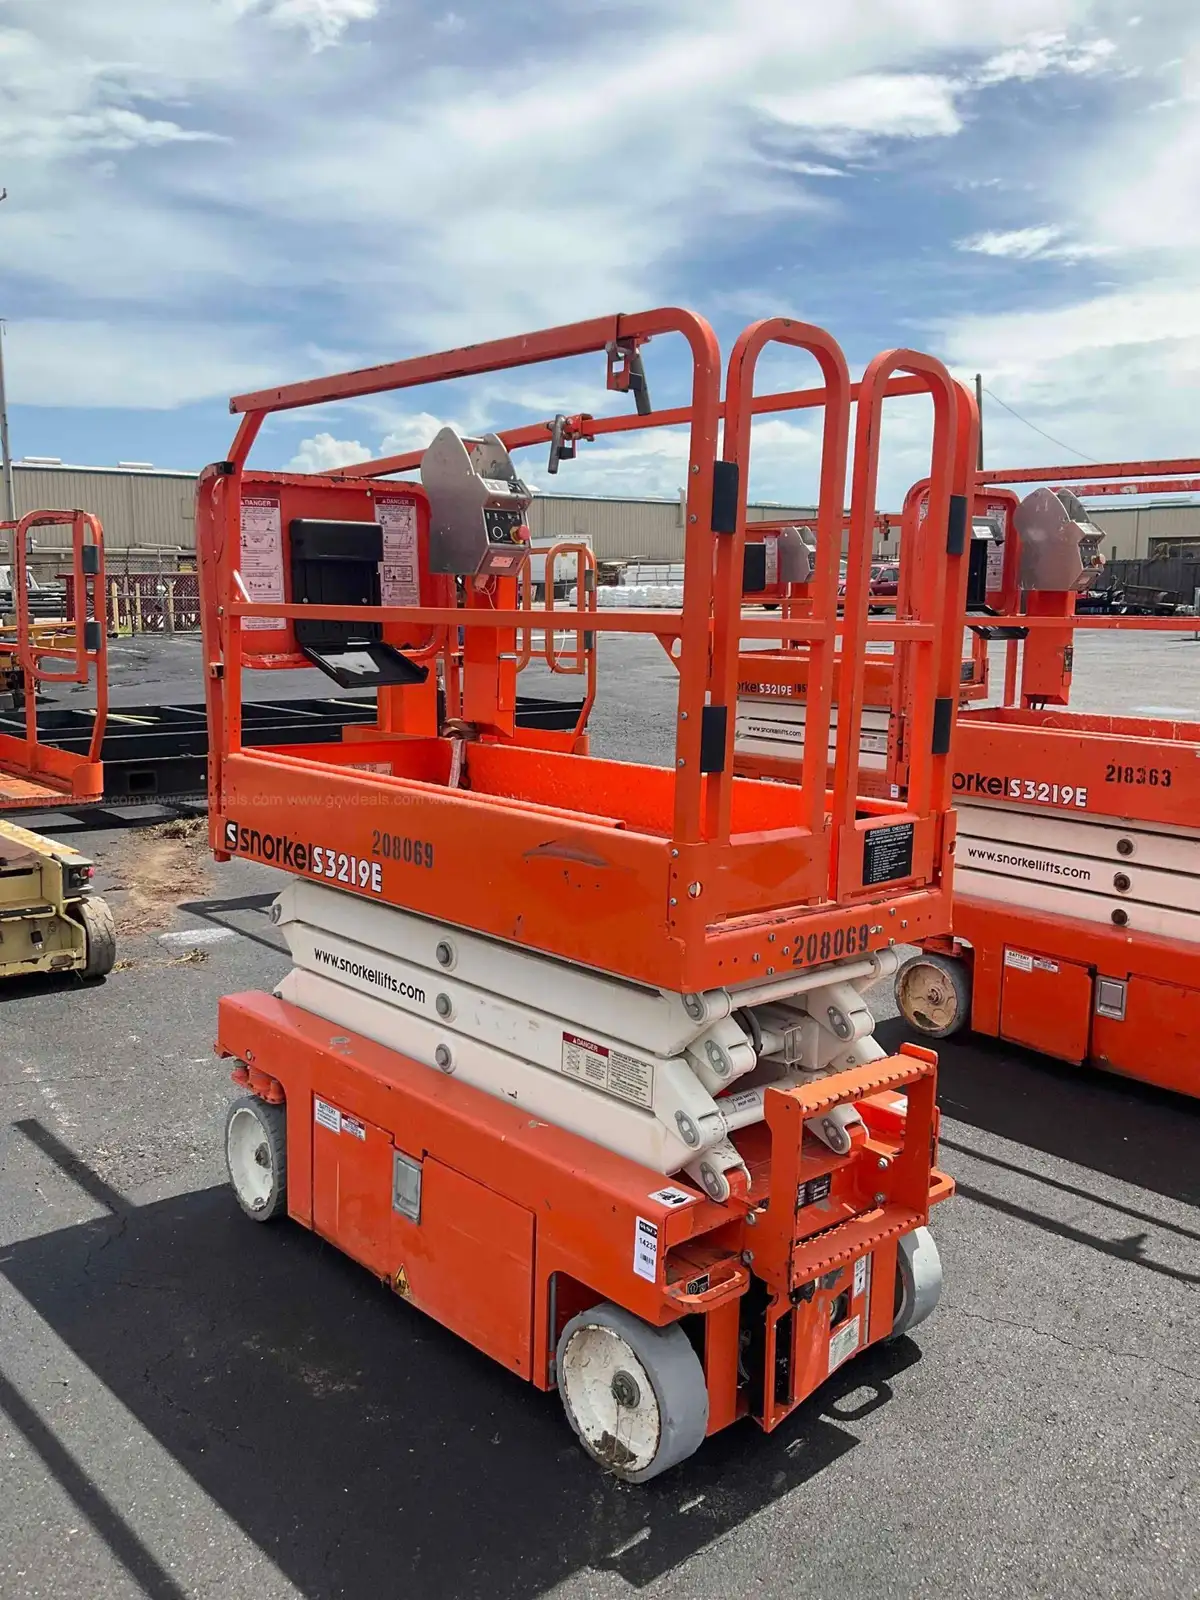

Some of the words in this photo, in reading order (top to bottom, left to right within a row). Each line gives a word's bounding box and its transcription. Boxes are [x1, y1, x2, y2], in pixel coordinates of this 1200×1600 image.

[244, 499, 272, 507] DANGER
[760, 683, 792, 696] S3219E
[1105, 764, 1172, 788] 218363
[1009, 778, 1088, 807] S3219E
[239, 827, 313, 872] snorkel
[312, 846, 383, 894] S3219E
[371, 829, 434, 869] 208069
[967, 847, 1092, 880] www.snorkellifts.com
[792, 923, 869, 965] 208069
[1008, 951, 1029, 961] BATTERY
[314, 947, 426, 1004] www.snorkellifts.com
[576, 1037, 599, 1053] DANGER
[318, 1101, 336, 1115] BATTERY
[639, 1237, 657, 1252] 14235
